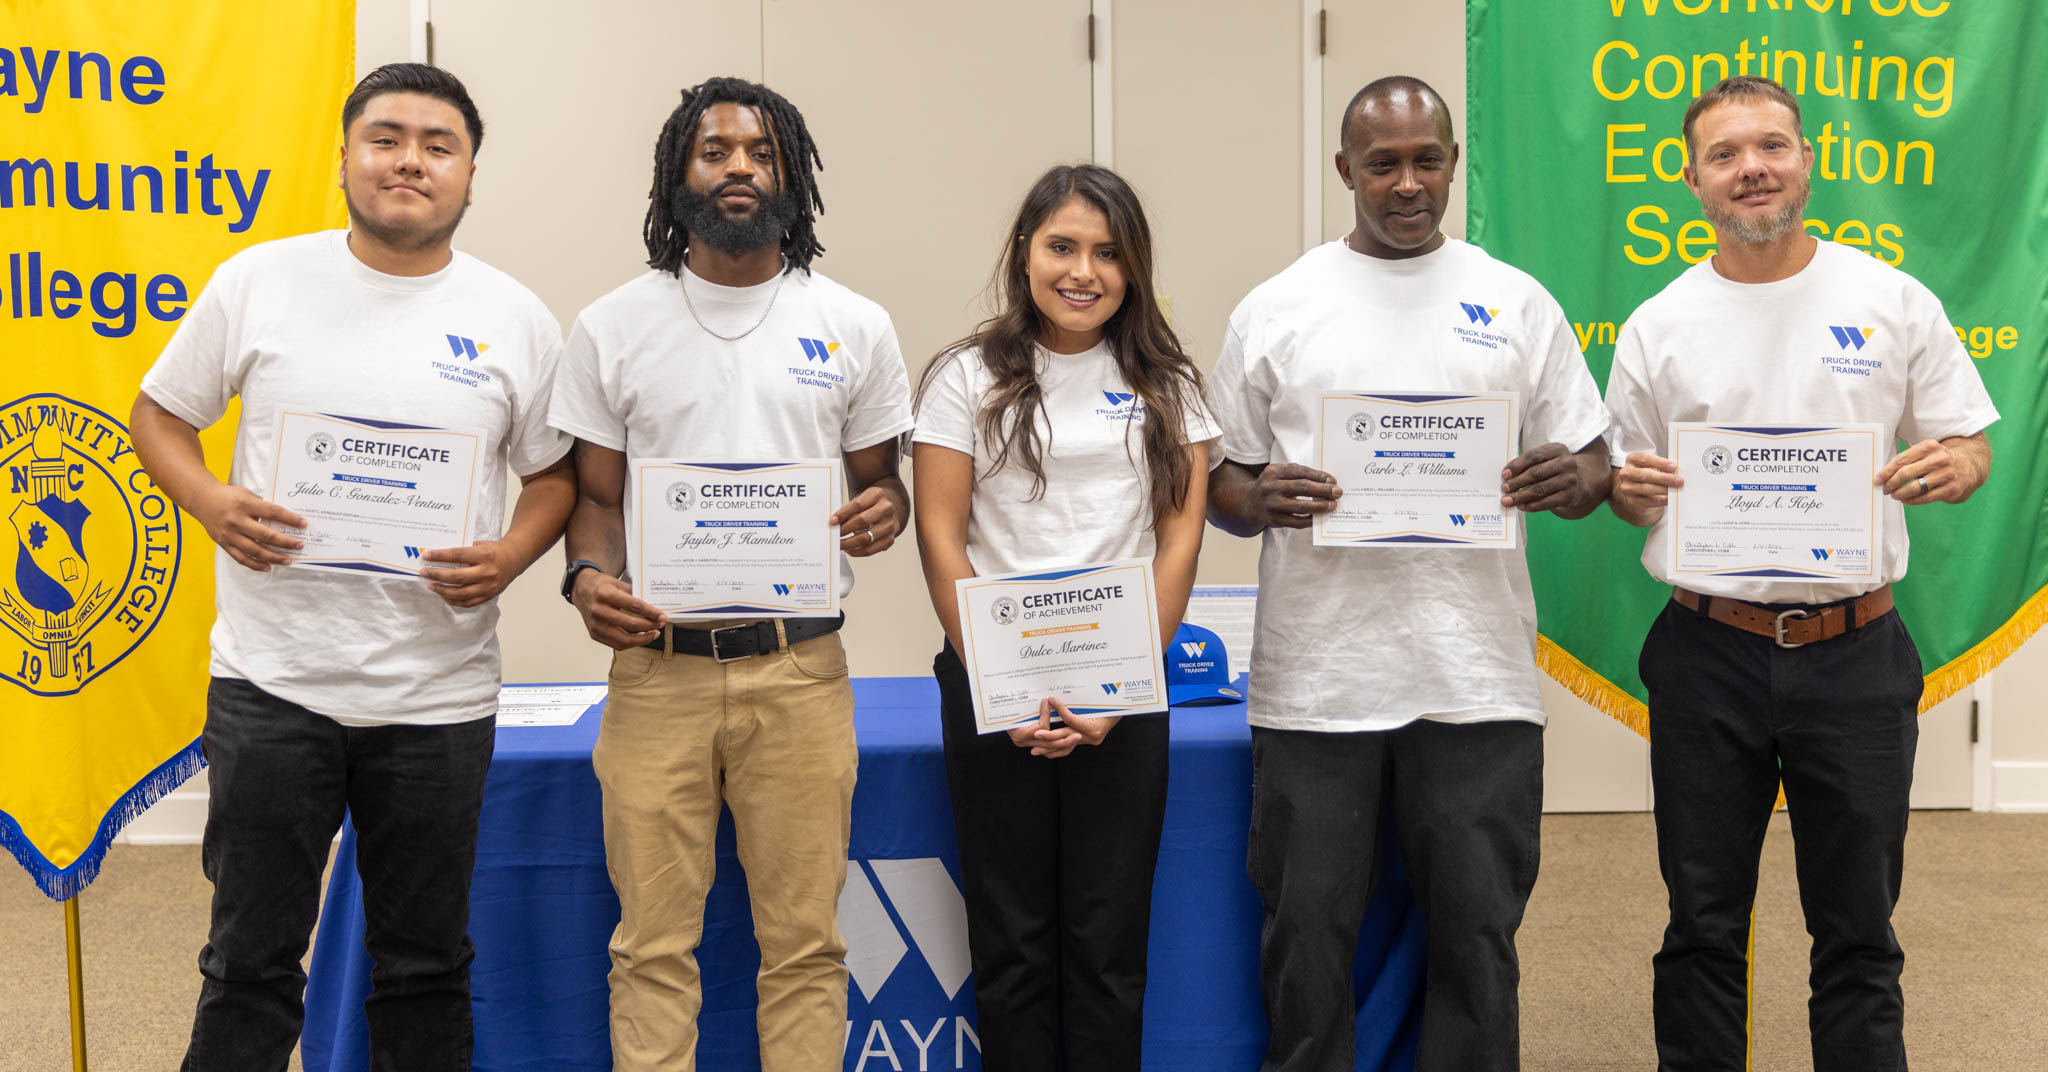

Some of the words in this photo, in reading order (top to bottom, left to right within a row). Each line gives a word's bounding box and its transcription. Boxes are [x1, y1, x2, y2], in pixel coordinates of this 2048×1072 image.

[1592, 36, 1954, 118] Continuing
[0, 251, 188, 338] llege
[1453, 327, 1480, 338] TRUCK
[1481, 332, 1508, 345] DRIVER
[1461, 336, 1498, 349] TRAINING
[431, 361, 461, 374] TRUCK
[462, 368, 491, 382] DRIVER
[1820, 357, 1851, 365] TRUCK
[1853, 358, 1882, 369] DRIVER
[1831, 366, 1870, 376] TRAINING
[439, 371, 478, 388] TRAINING
[788, 367, 816, 377] TRUCK
[818, 371, 845, 384] DRIVER
[796, 377, 832, 389] TRAINING
[1380, 415, 1485, 430] CERTIFICATE
[1395, 432, 1458, 441] COMPLETION
[342, 438, 450, 463] CERTIFICATE
[1737, 448, 1848, 462] CERTIFICATE
[339, 454, 354, 463] OF
[356, 456, 421, 471] COMPLETION
[1364, 462, 1397, 475] Carlo
[1417, 462, 1467, 476] Williams
[1736, 464, 1751, 472] OF
[1753, 464, 1819, 473] COMPLETION
[288, 481, 324, 497] Julio
[346, 487, 454, 511] Gonzalez-Ventura
[700, 484, 807, 498] CERTIFICATE
[700, 501, 714, 509] OF
[716, 501, 780, 509] COMPLETION
[1724, 494, 1765, 512] Lloyd
[1788, 495, 1824, 514] Hope
[675, 532, 718, 549] Jaylin
[738, 532, 797, 545] Hamilton
[1836, 548, 1868, 556] WAYNE
[1022, 585, 1124, 609] CERTIFICATE
[11, 607, 32, 628] LABOR
[42, 630, 73, 640] OMNIA
[78, 600, 96, 623] VINCIT
[1023, 611, 1037, 620] OF
[1038, 603, 1103, 618] ACHIEVEMENT
[1019, 644, 1054, 659] Dulce
[1055, 640, 1108, 655] Martinez
[1124, 679, 1153, 687] WAYNE
